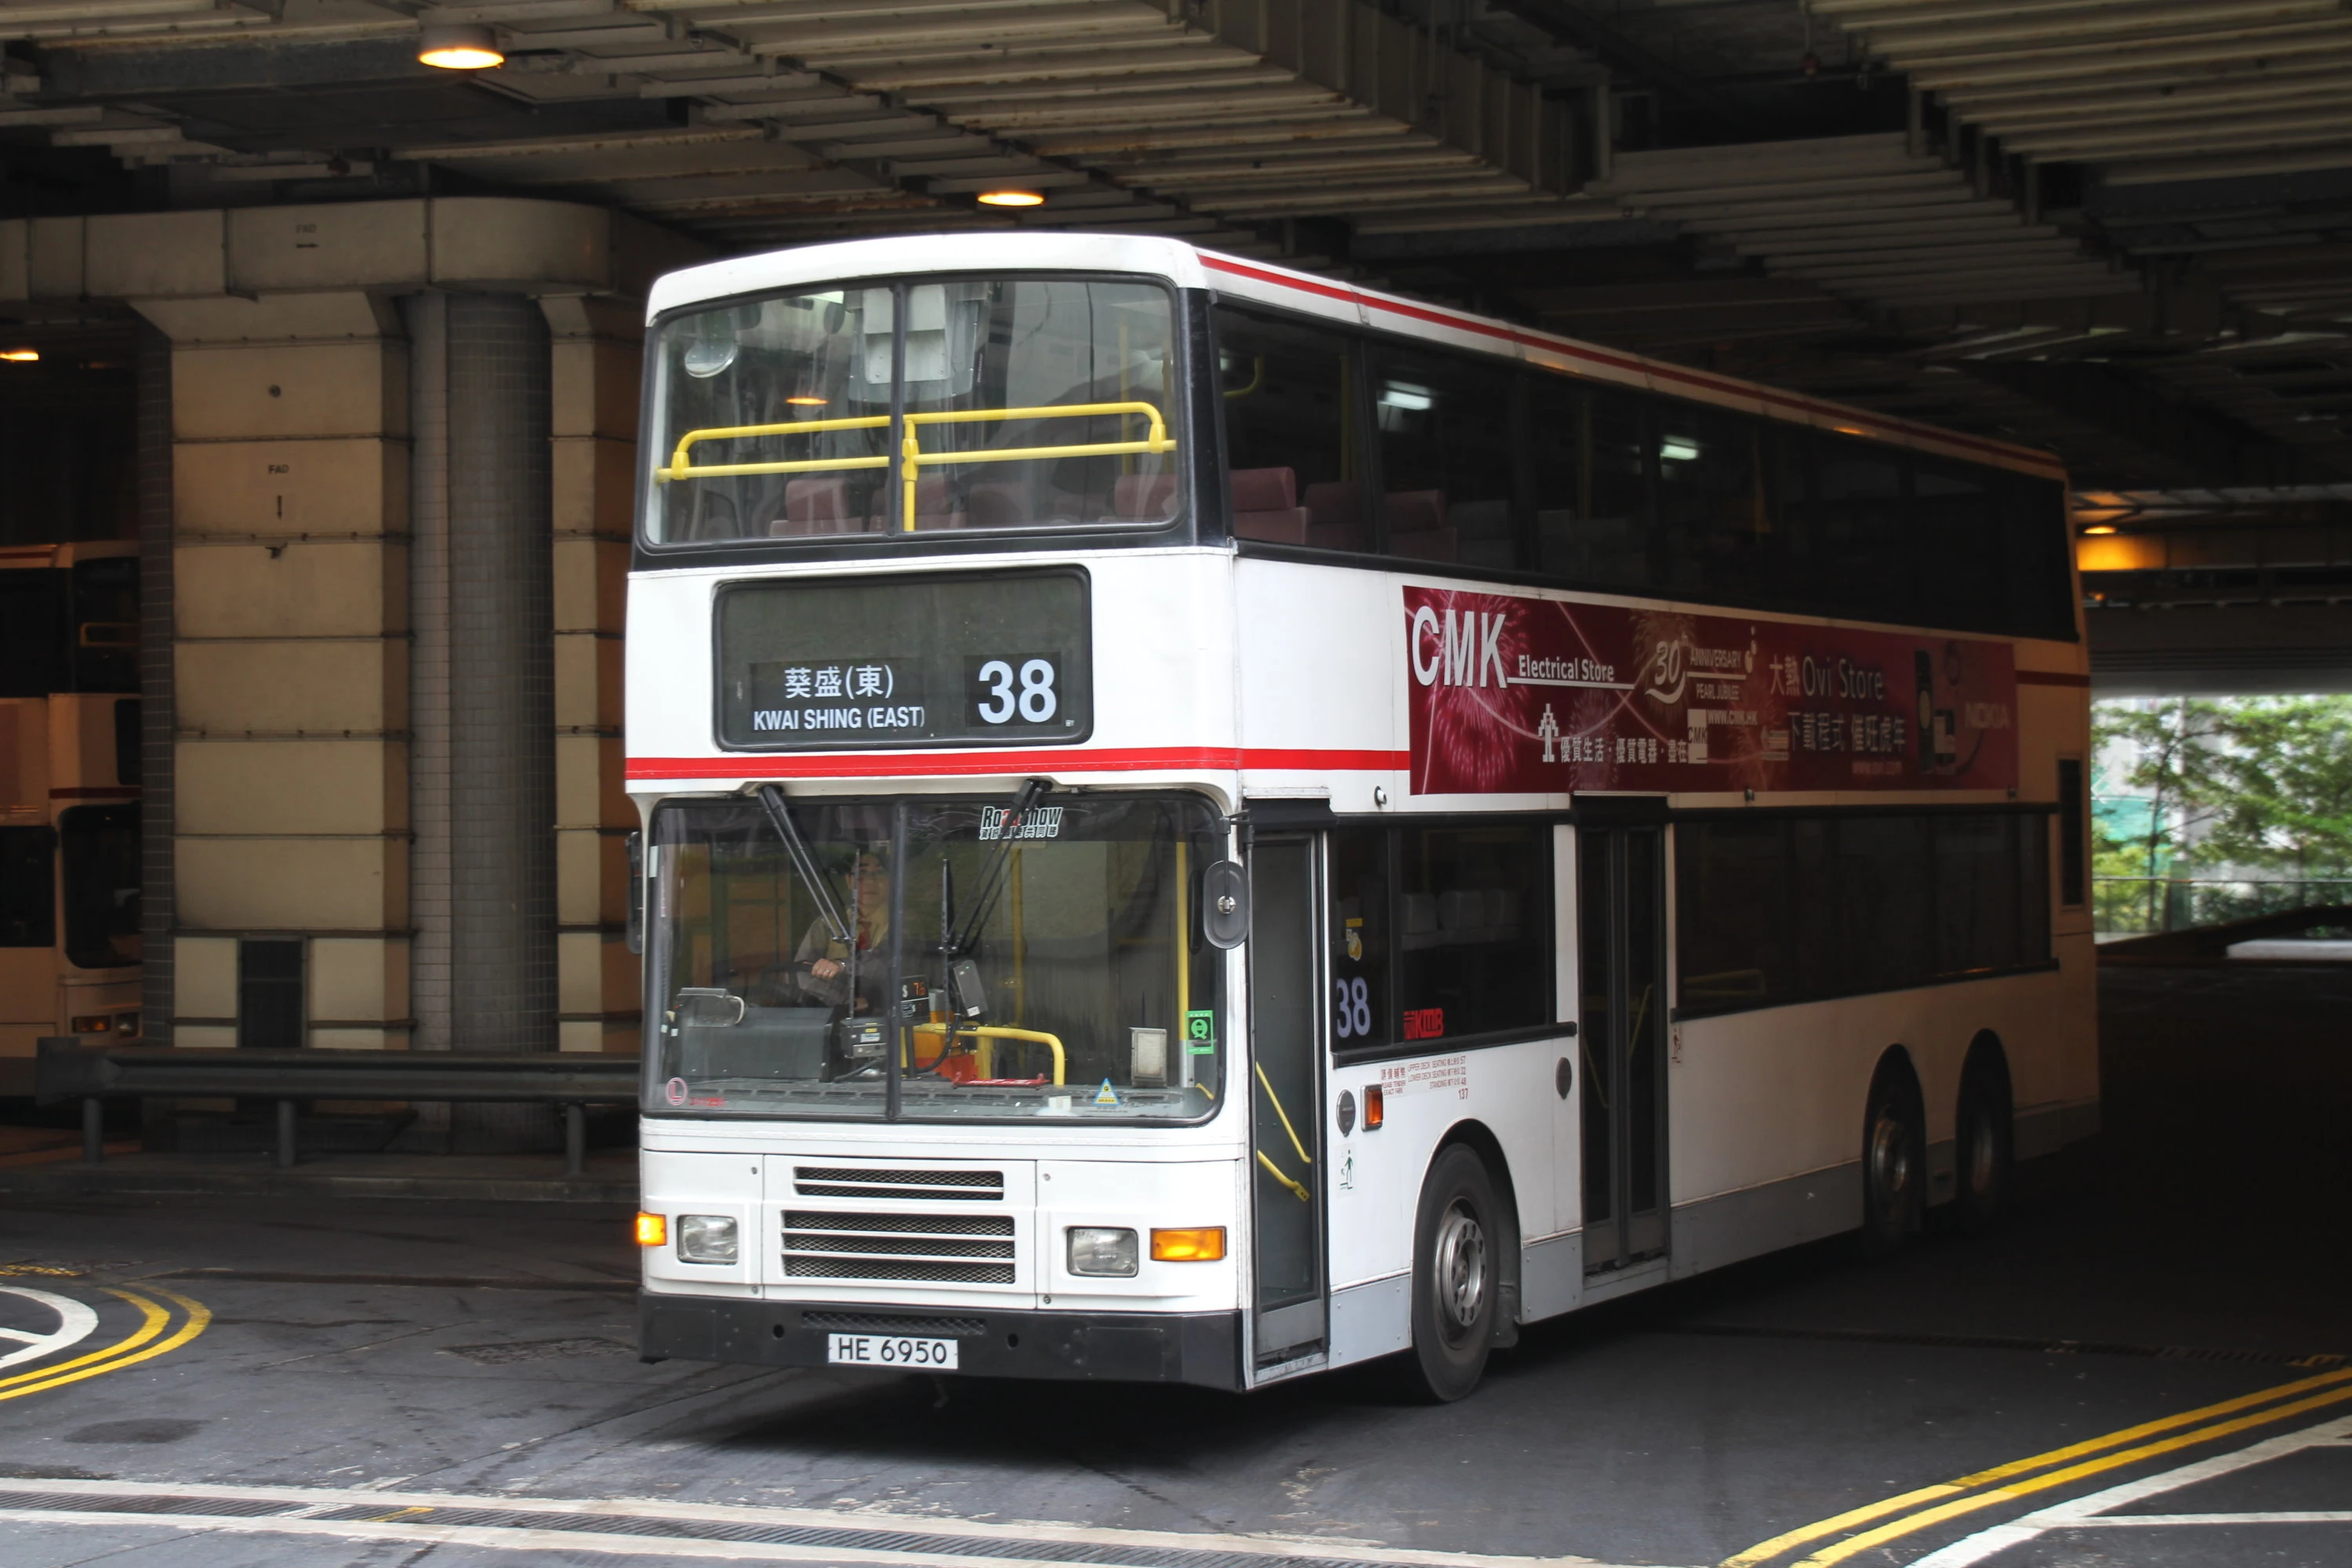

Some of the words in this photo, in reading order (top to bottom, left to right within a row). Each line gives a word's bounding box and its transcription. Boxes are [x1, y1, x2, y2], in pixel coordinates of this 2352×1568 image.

[268, 464, 289, 474] FAD
[1412, 605, 1507, 688] CMK
[1690, 648, 1741, 668] ANNIVERSARY
[1518, 655, 1579, 680] Electrical
[1582, 659, 1615, 682] Store
[1802, 655, 1832, 697] Ovi
[1838, 659, 1885, 700] Store
[785, 665, 893, 699] 葵盛(東)
[978, 659, 1057, 724] 38
[1696, 683, 1715, 699] PEARL
[1717, 684, 1740, 700] JUBILEE
[753, 709, 799, 731] KWAI
[804, 707, 862, 729] SHING
[867, 706, 925, 728] (EAST)
[1965, 701, 2010, 730] NOKIA
[1687, 727, 1708, 744] CMK
[1337, 977, 1370, 1038] 38
[1414, 1008, 1444, 1039] KMB
[1461, 1066, 1466, 1075] 32
[1458, 1088, 1468, 1100] 137
[839, 1338, 869, 1360] HE
[880, 1339, 946, 1364] 6950
